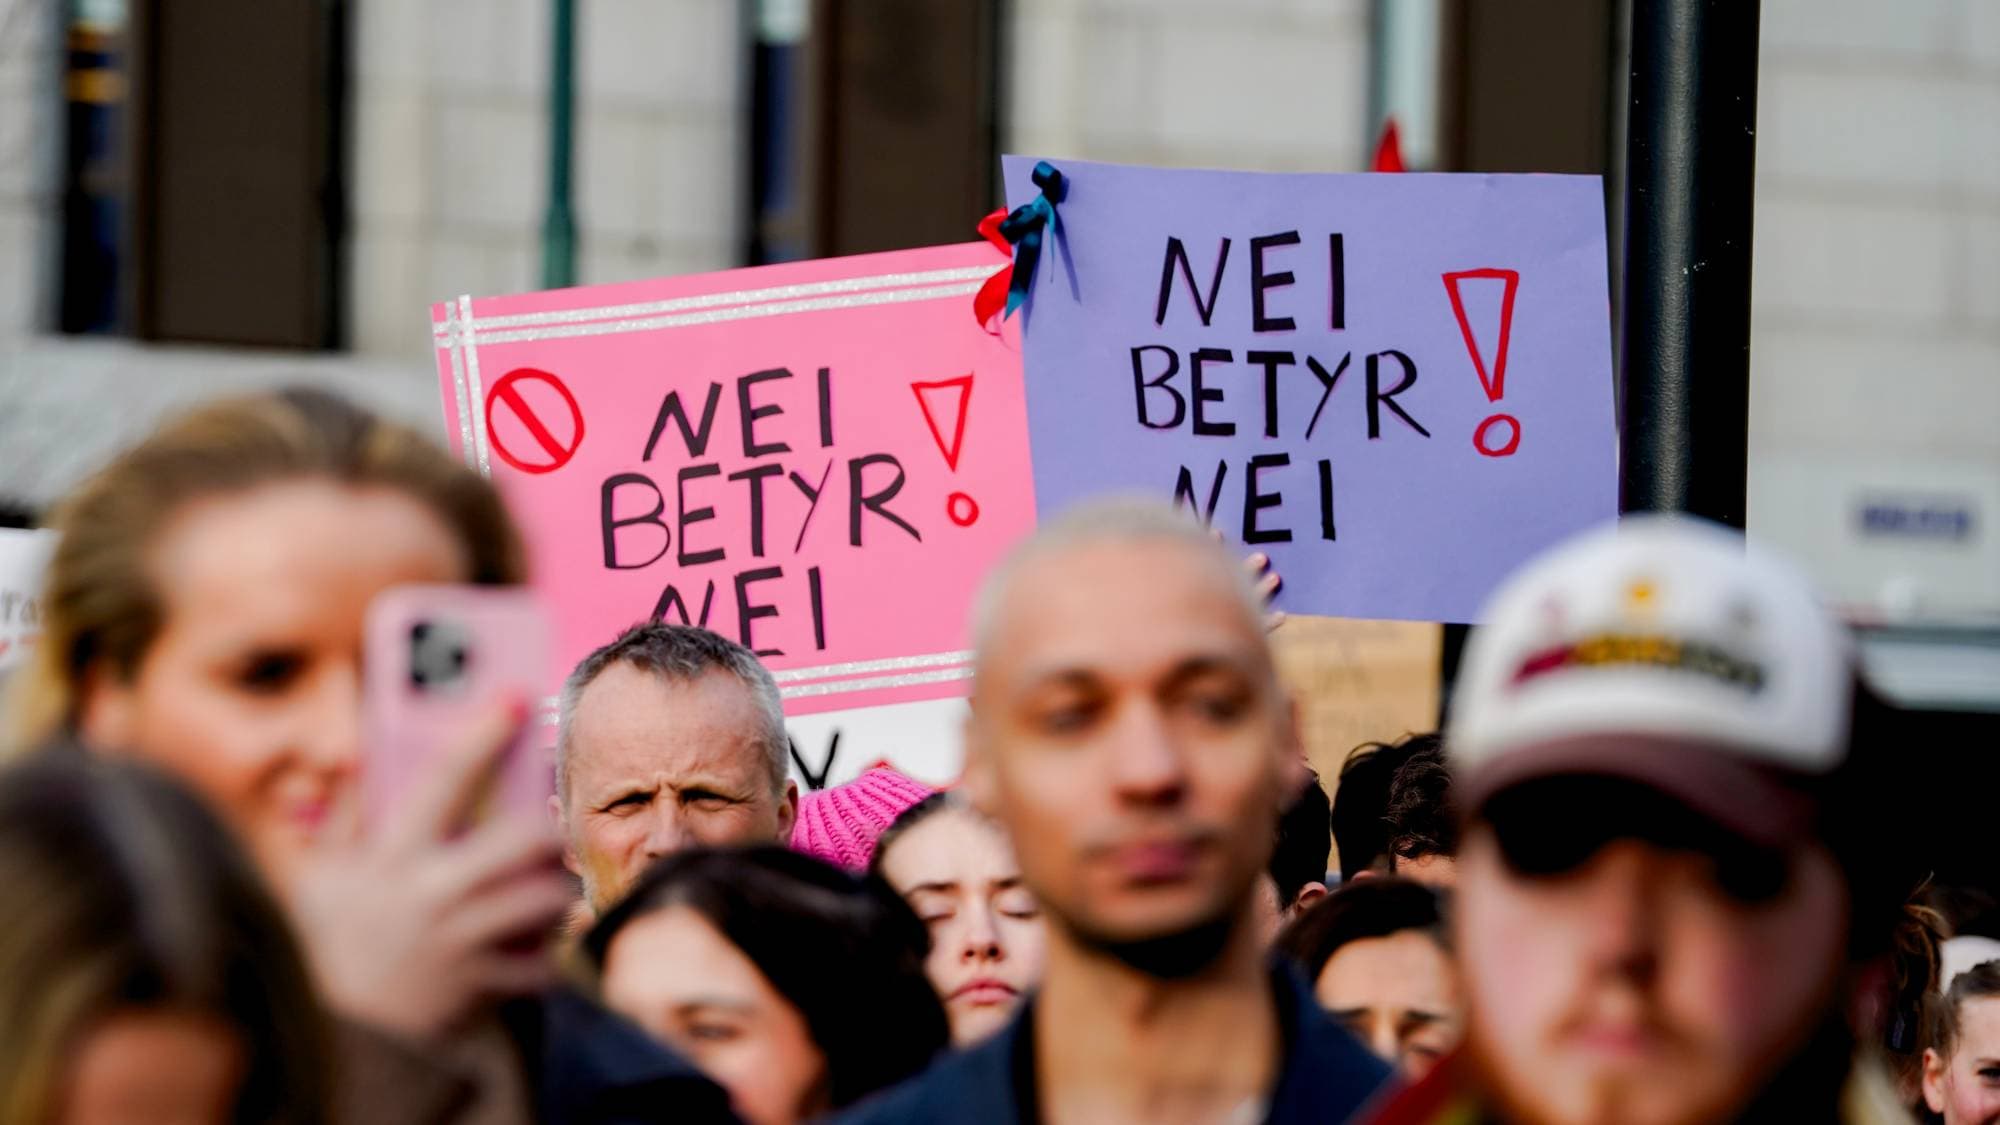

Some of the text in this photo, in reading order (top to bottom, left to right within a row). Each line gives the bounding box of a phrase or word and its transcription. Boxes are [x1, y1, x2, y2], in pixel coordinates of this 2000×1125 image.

[1154, 230, 1346, 333] NEI
[641, 367, 834, 461] NEI
[1130, 346, 1431, 440] BETYR
[600, 453, 922, 569] BETYR
